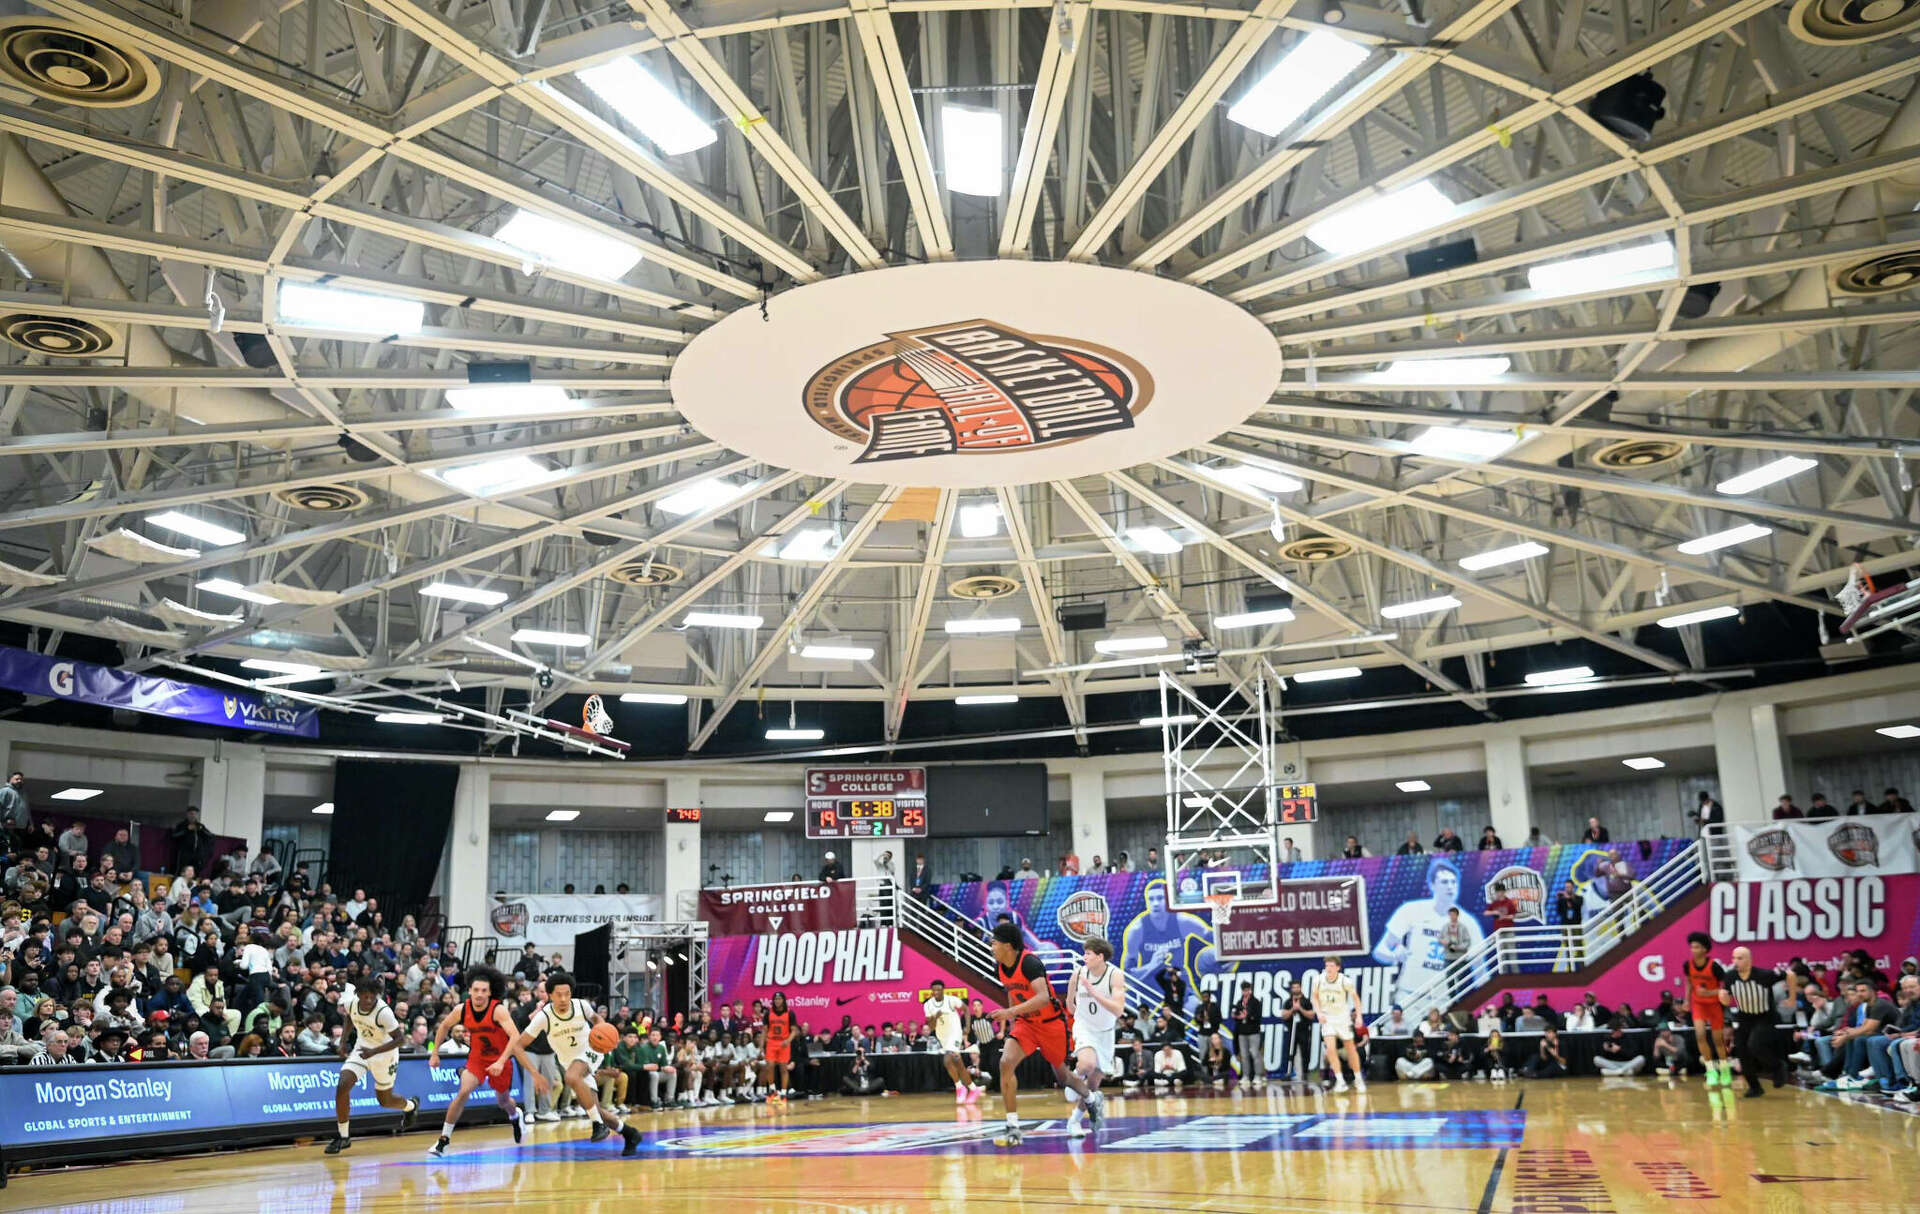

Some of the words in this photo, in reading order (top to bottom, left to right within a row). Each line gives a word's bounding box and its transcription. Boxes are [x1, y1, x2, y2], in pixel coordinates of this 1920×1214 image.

[813, 349, 886, 408] SPRINGFIELD
[932, 330, 1124, 438] BASKETBALL
[936, 383, 1013, 424] HALL
[865, 410, 953, 459] FAME
[959, 423, 1029, 446] OF
[49, 662, 74, 696] G
[829, 773, 905, 783] SPRINGFIELD
[841, 783, 894, 792] COLLEGE
[811, 801, 833, 809] HOME
[851, 800, 893, 818] 6:38
[896, 800, 925, 808] VISITOR
[1282, 799, 1312, 823] 27
[820, 810, 836, 827] 19
[903, 809, 924, 826] 25
[873, 821, 883, 836] 2
[721, 886, 831, 905] SPRINGFIELD
[1299, 889, 1351, 910] COLLEGE
[533, 914, 591, 924] GREATNESS
[748, 903, 804, 914] COLLEGE
[1709, 876, 1885, 943] CLASSIC
[1222, 929, 1278, 950] BIRTHPLACE
[1282, 929, 1294, 947] OF
[1299, 926, 1360, 947] BASKETBALL
[754, 927, 903, 986] HOOPHALL
[1639, 955, 1665, 982] G
[1344, 966, 1399, 1014] THE
[795, 995, 830, 1010] Stanley
[1089, 1001, 1097, 1015] 0
[268, 1071, 320, 1093] Morgan
[429, 1066, 460, 1085] Morg
[35, 1082, 107, 1107] Morgan
[108, 1077, 172, 1102] Stanley
[262, 1103, 292, 1114] GLOBAL
[294, 1101, 322, 1111] SPORTS
[24, 1119, 65, 1132] GLOBAL
[68, 1116, 107, 1129] SPORTS
[109, 1115, 116, 1126] &
[118, 1110, 192, 1125] ENTERTAINMENT
[1512, 1150, 1617, 1214] PRINGFIELD
